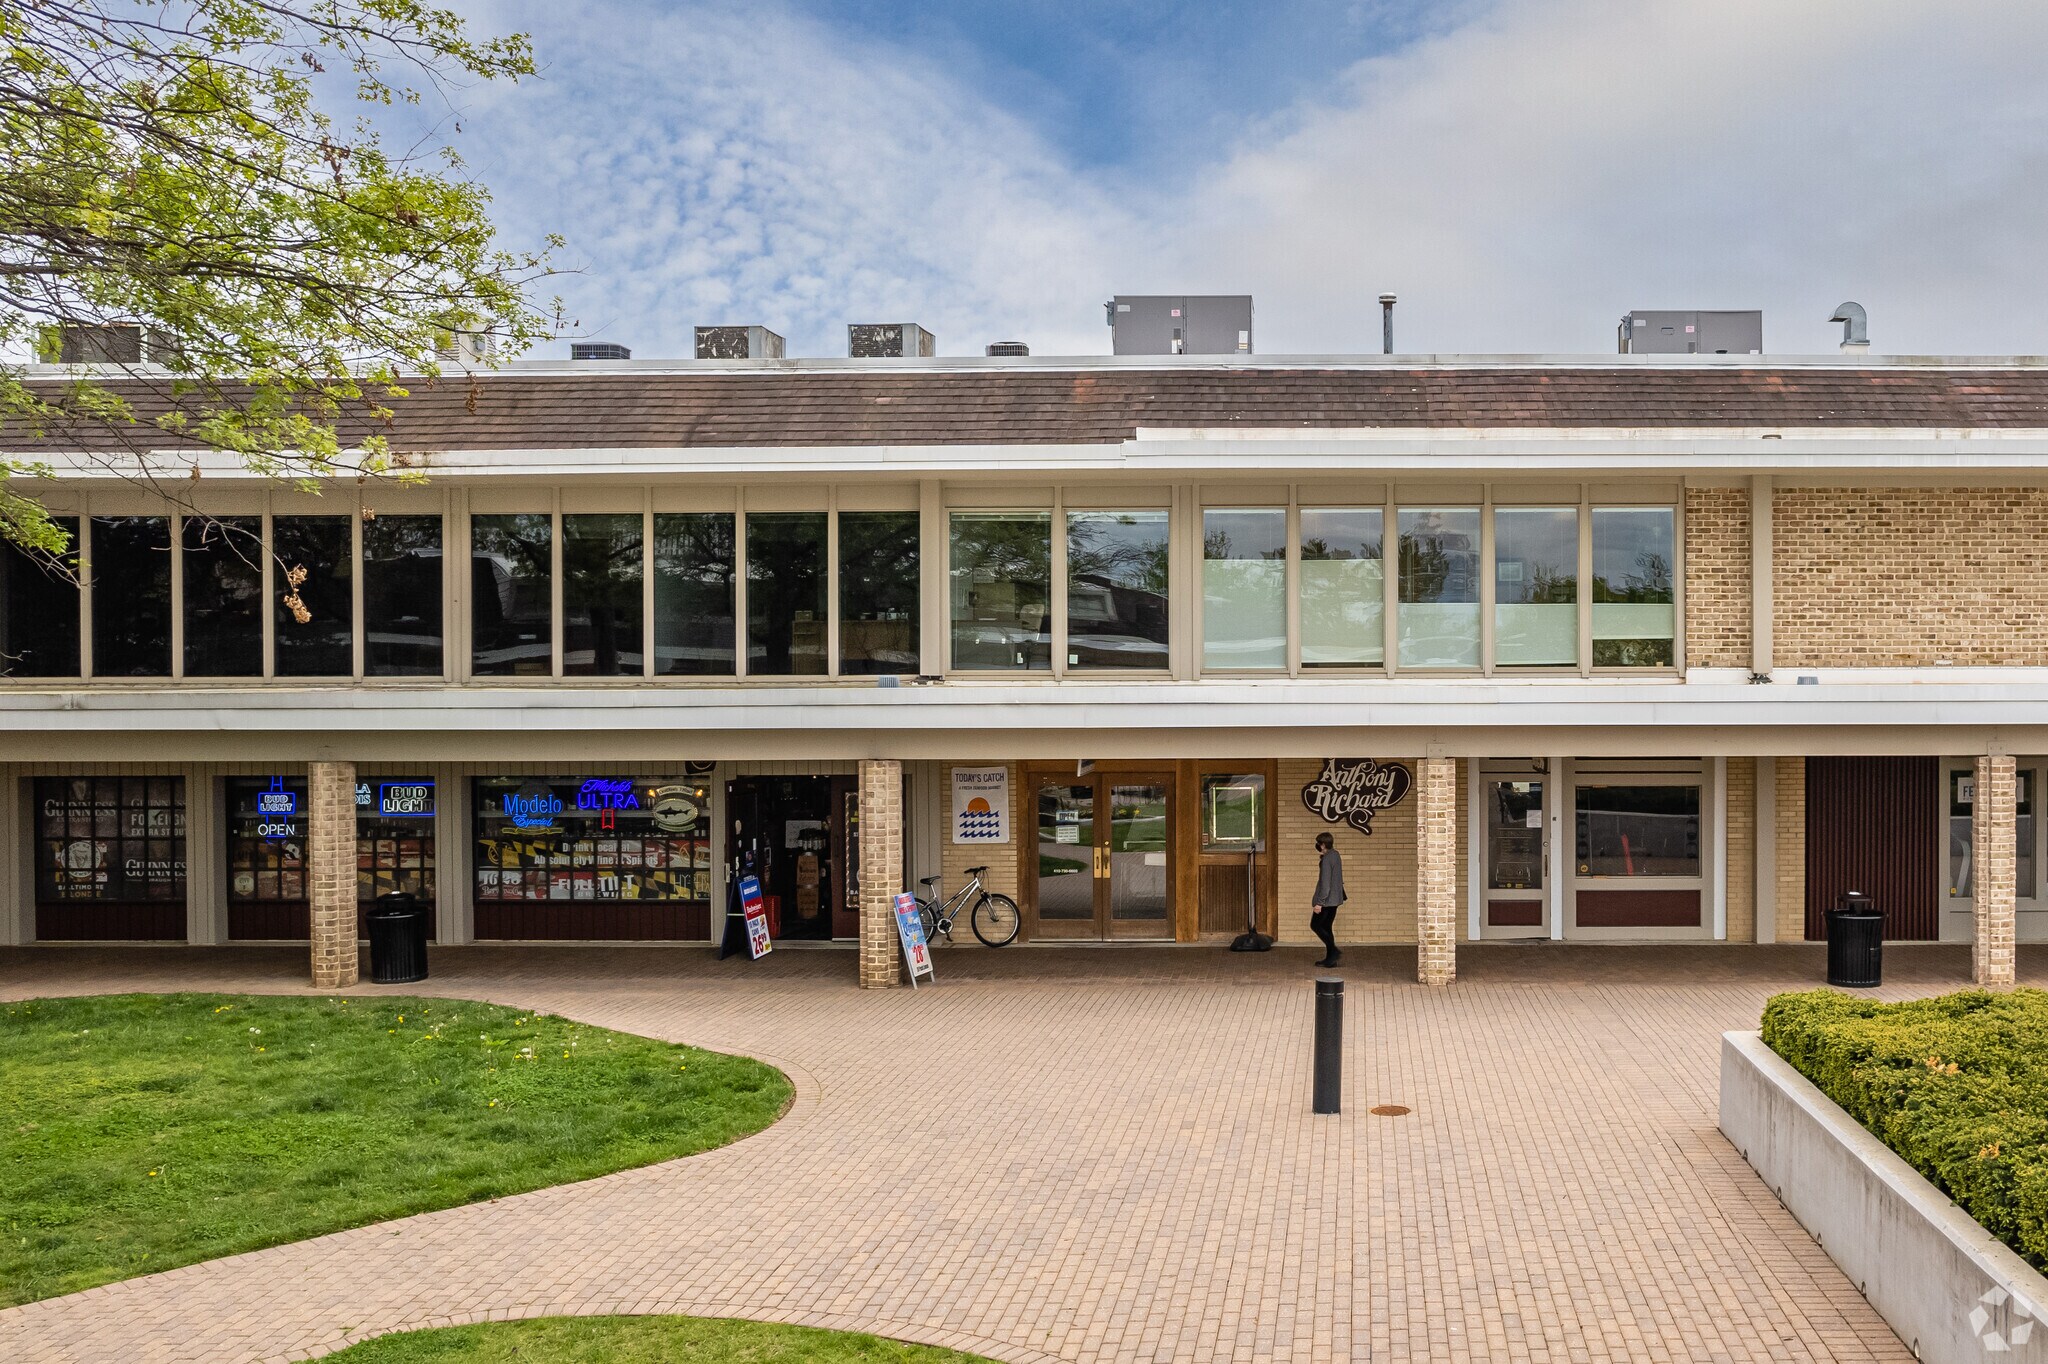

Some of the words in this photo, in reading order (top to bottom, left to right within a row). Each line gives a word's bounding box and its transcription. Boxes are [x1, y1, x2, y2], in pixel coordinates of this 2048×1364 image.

[955, 773, 982, 783] TODAY'S
[983, 772, 1005, 783] CATCH
[1319, 758, 1396, 793] Anthony
[264, 794, 289, 804] BUD
[391, 786, 428, 800] BUD
[260, 803, 293, 812] LIGHT
[503, 793, 563, 815] Modelo
[577, 792, 639, 810] ULTRA
[1305, 784, 1395, 822] Richard
[512, 814, 554, 828] Especial
[258, 823, 296, 836] OPEN
[125, 859, 188, 877] GUINNES
